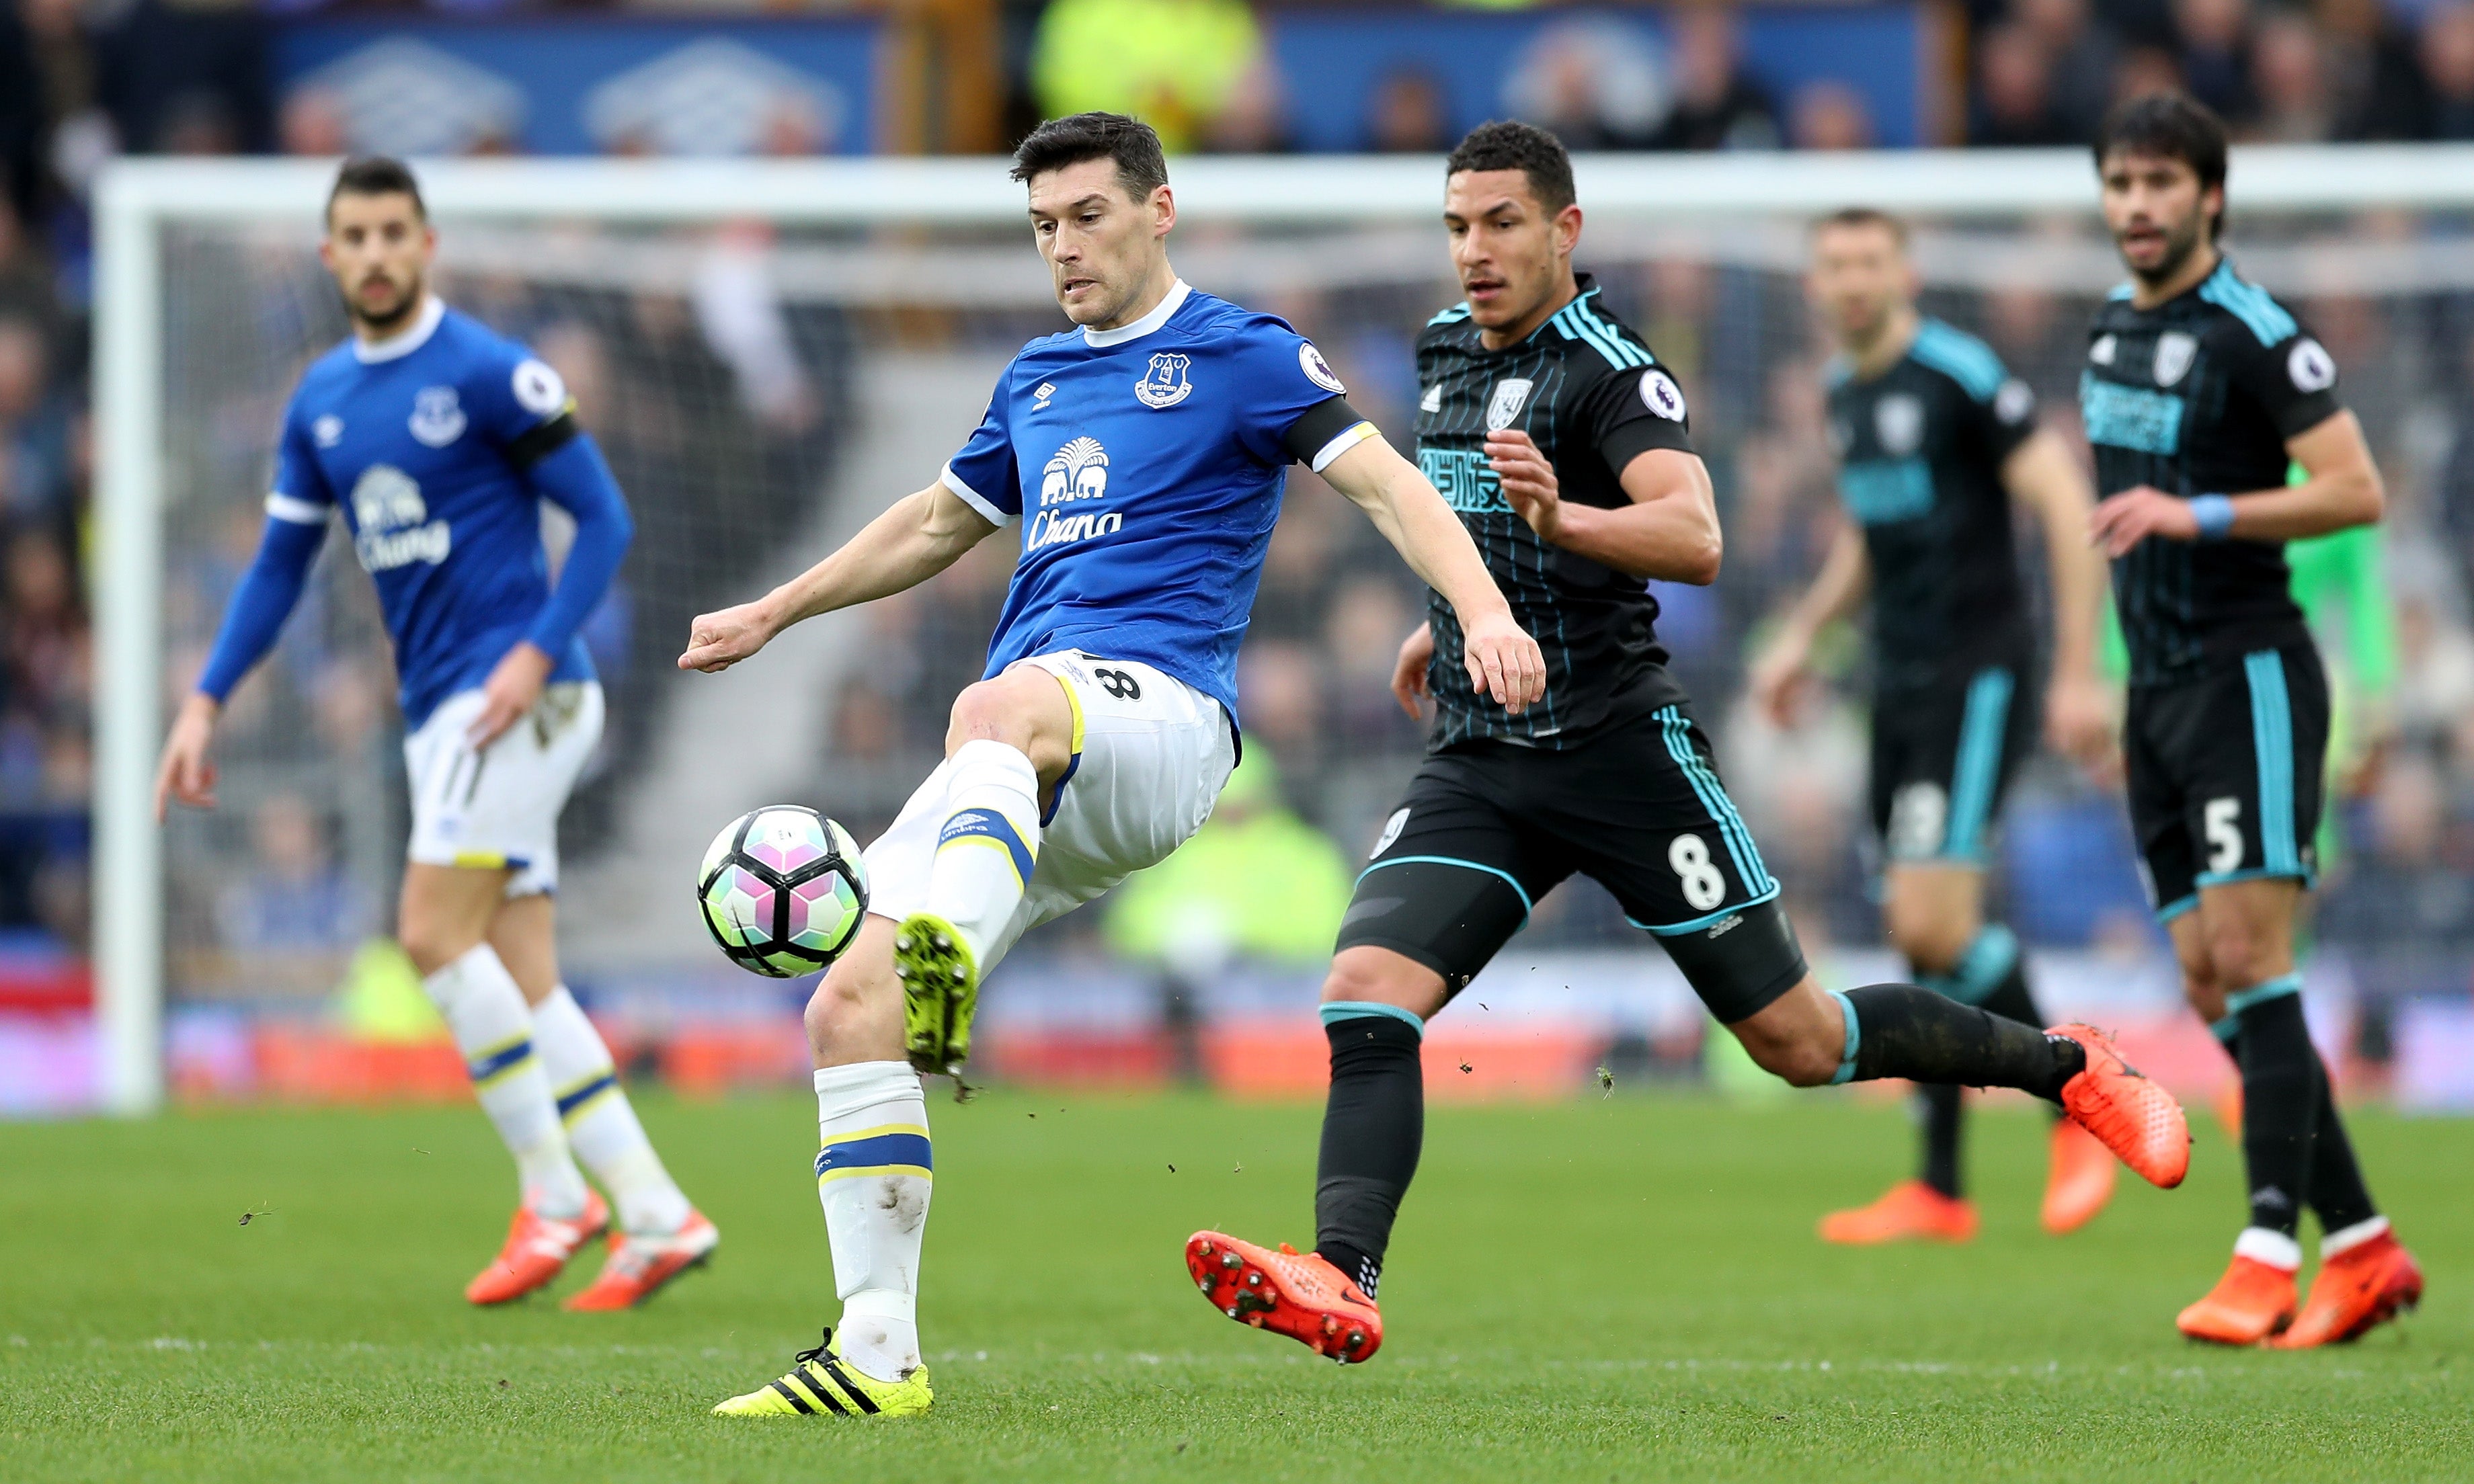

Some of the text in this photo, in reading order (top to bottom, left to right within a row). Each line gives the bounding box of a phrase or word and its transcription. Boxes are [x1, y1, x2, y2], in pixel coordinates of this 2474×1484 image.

[1148, 382, 1177, 392] Everton
[941, 825, 988, 841] umbro
[2205, 797, 2243, 874] 5
[1668, 833, 1726, 910] 8
